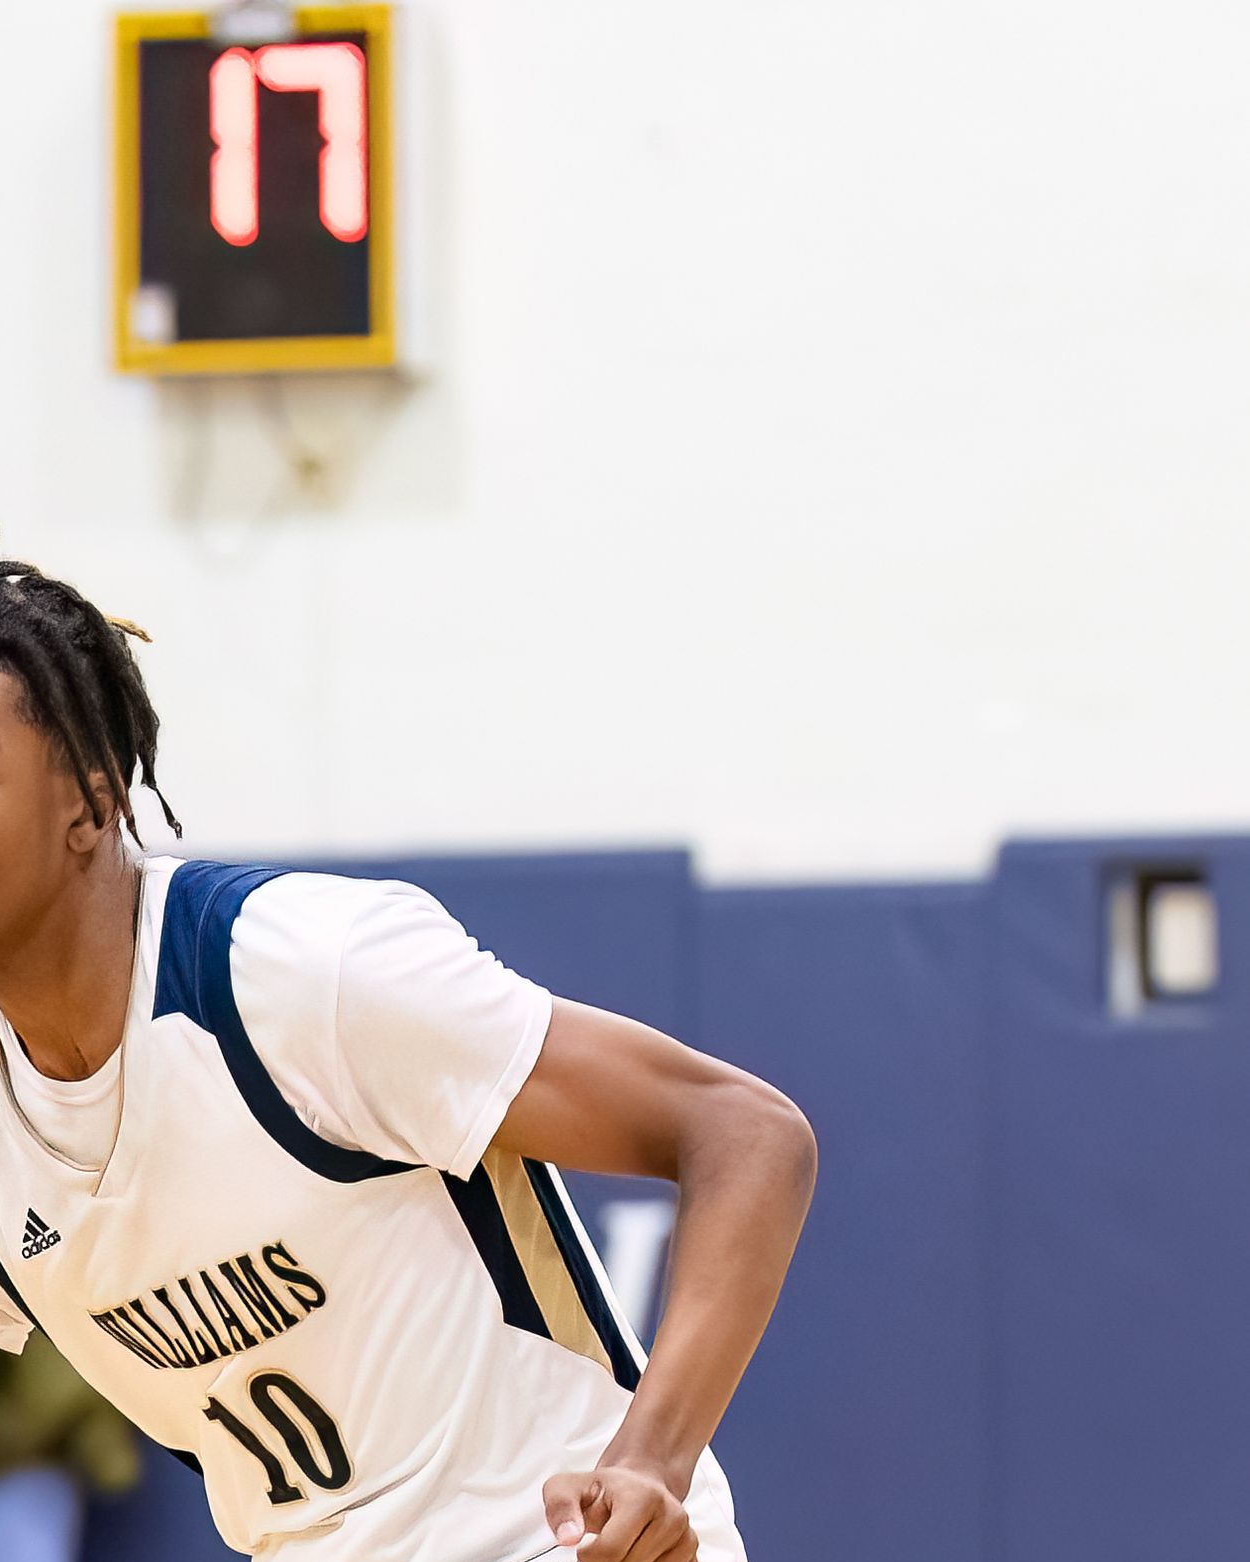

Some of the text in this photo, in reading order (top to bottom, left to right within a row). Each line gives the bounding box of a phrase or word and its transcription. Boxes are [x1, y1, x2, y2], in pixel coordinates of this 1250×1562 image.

[209, 42, 368, 247] 17
[21, 1229, 62, 1260] adidas
[87, 1239, 327, 1370] WILLIAMS
[201, 1370, 354, 1506] 10
